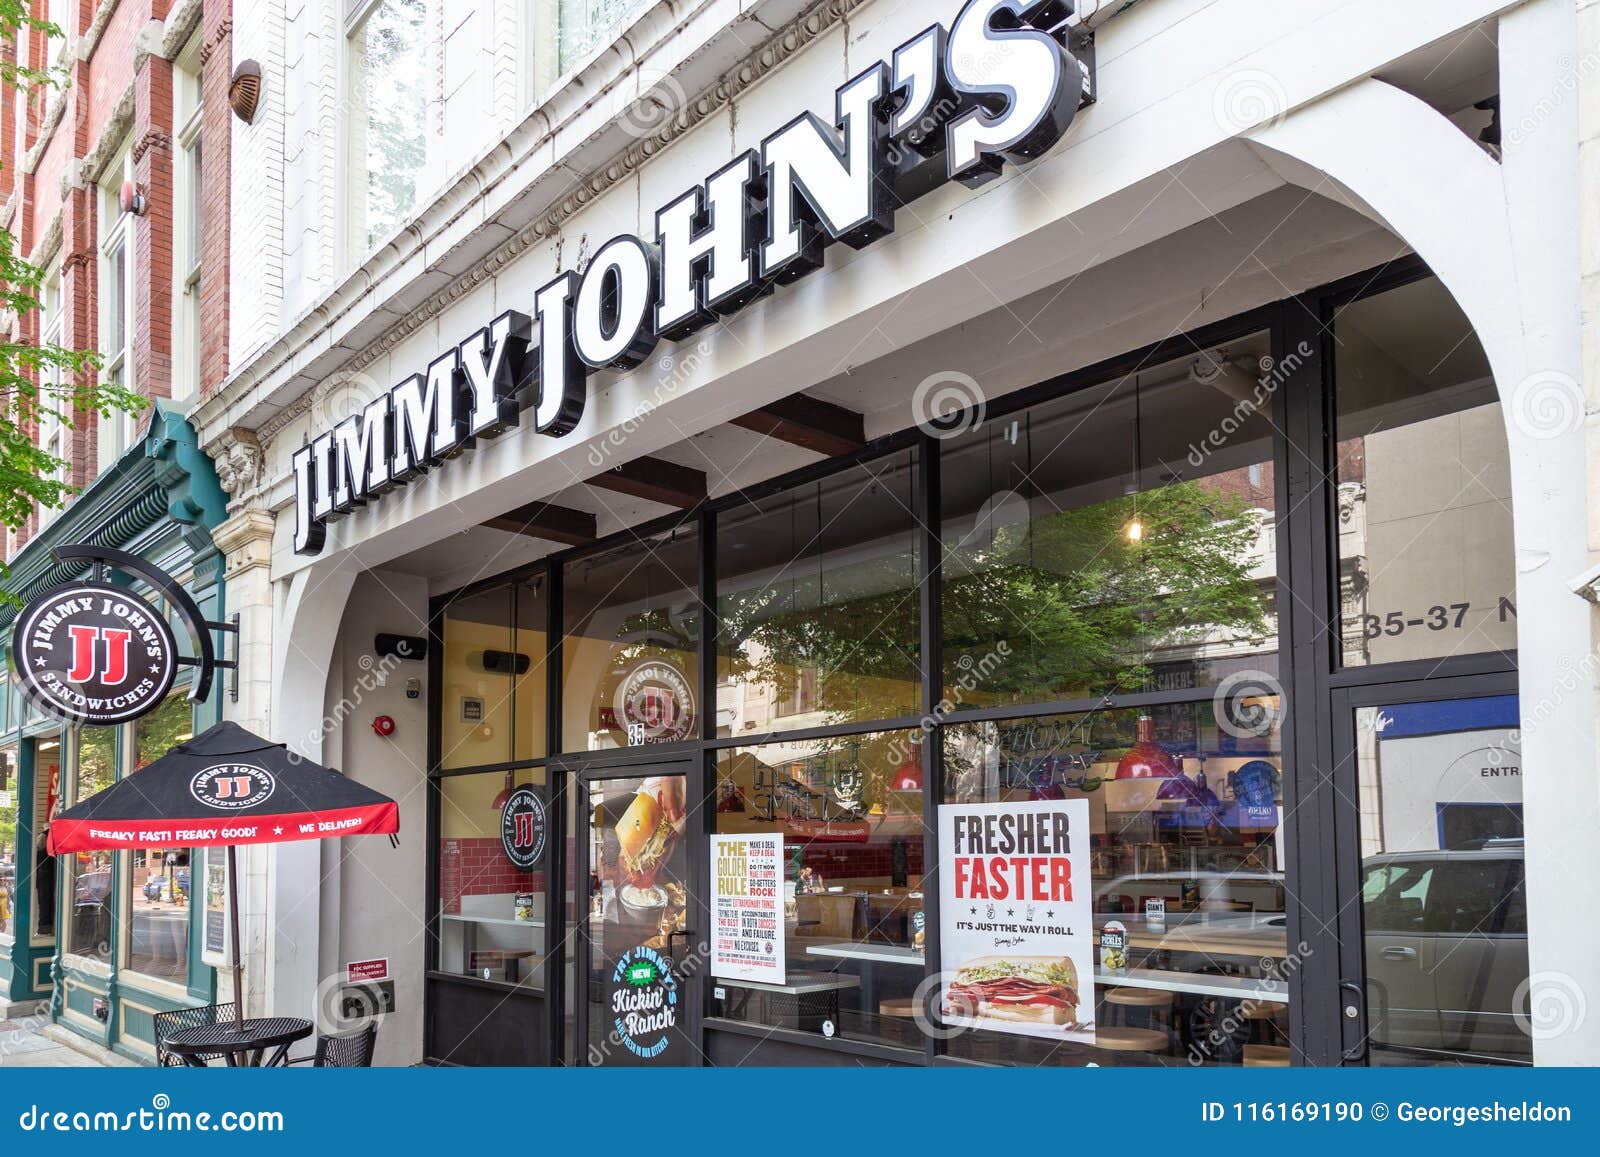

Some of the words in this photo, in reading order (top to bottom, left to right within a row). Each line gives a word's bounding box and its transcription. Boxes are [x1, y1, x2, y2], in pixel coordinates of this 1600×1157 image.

[293, 310, 531, 554] JIMMY
[535, 0, 1082, 436] JOHN'S
[33, 597, 93, 650] JIMMY
[101, 598, 162, 660] JOHN'S
[1363, 602, 1470, 640] 35-37
[67, 624, 132, 685] JJ
[41, 672, 154, 710] SANDWICHES
[629, 725, 643, 745] 35
[196, 767, 228, 788] JIMMY
[232, 766, 270, 786] JOHN'S
[1481, 766, 1522, 777] ENTR
[214, 775, 252, 798] JJ
[202, 791, 266, 807] SANDWICHES
[90, 828, 135, 841] FREAKY
[139, 830, 171, 841] FAST!
[176, 828, 217, 840] FREAKY
[221, 827, 257, 839] GOOD!
[299, 823, 315, 834] WE
[319, 818, 362, 832] DELIVER!
[514, 812, 533, 847] JJ
[953, 812, 1071, 855] FRESHER
[717, 841, 747, 857] THE
[717, 857, 747, 876] GOLDEN
[717, 878, 747, 896] RULE
[954, 856, 1073, 902] FASTER
[750, 888, 776, 897] ROCK!
[718, 918, 726, 926] THE
[727, 918, 738, 927] BEST
[742, 910, 776, 919] ACCOUNTABILITY
[742, 929, 752, 938] AND
[753, 929, 776, 940] FAILURE.
[956, 922, 973, 930] IT'S
[975, 923, 998, 932] JUST
[998, 924, 1018, 933] THE
[1019, 925, 1041, 934] WAY
[1047, 926, 1074, 936] ROLL
[613, 950, 631, 983] TRY
[631, 968, 651, 979] NEW
[612, 986, 664, 1013] Kickin'
[625, 1005, 676, 1036] Ranch
